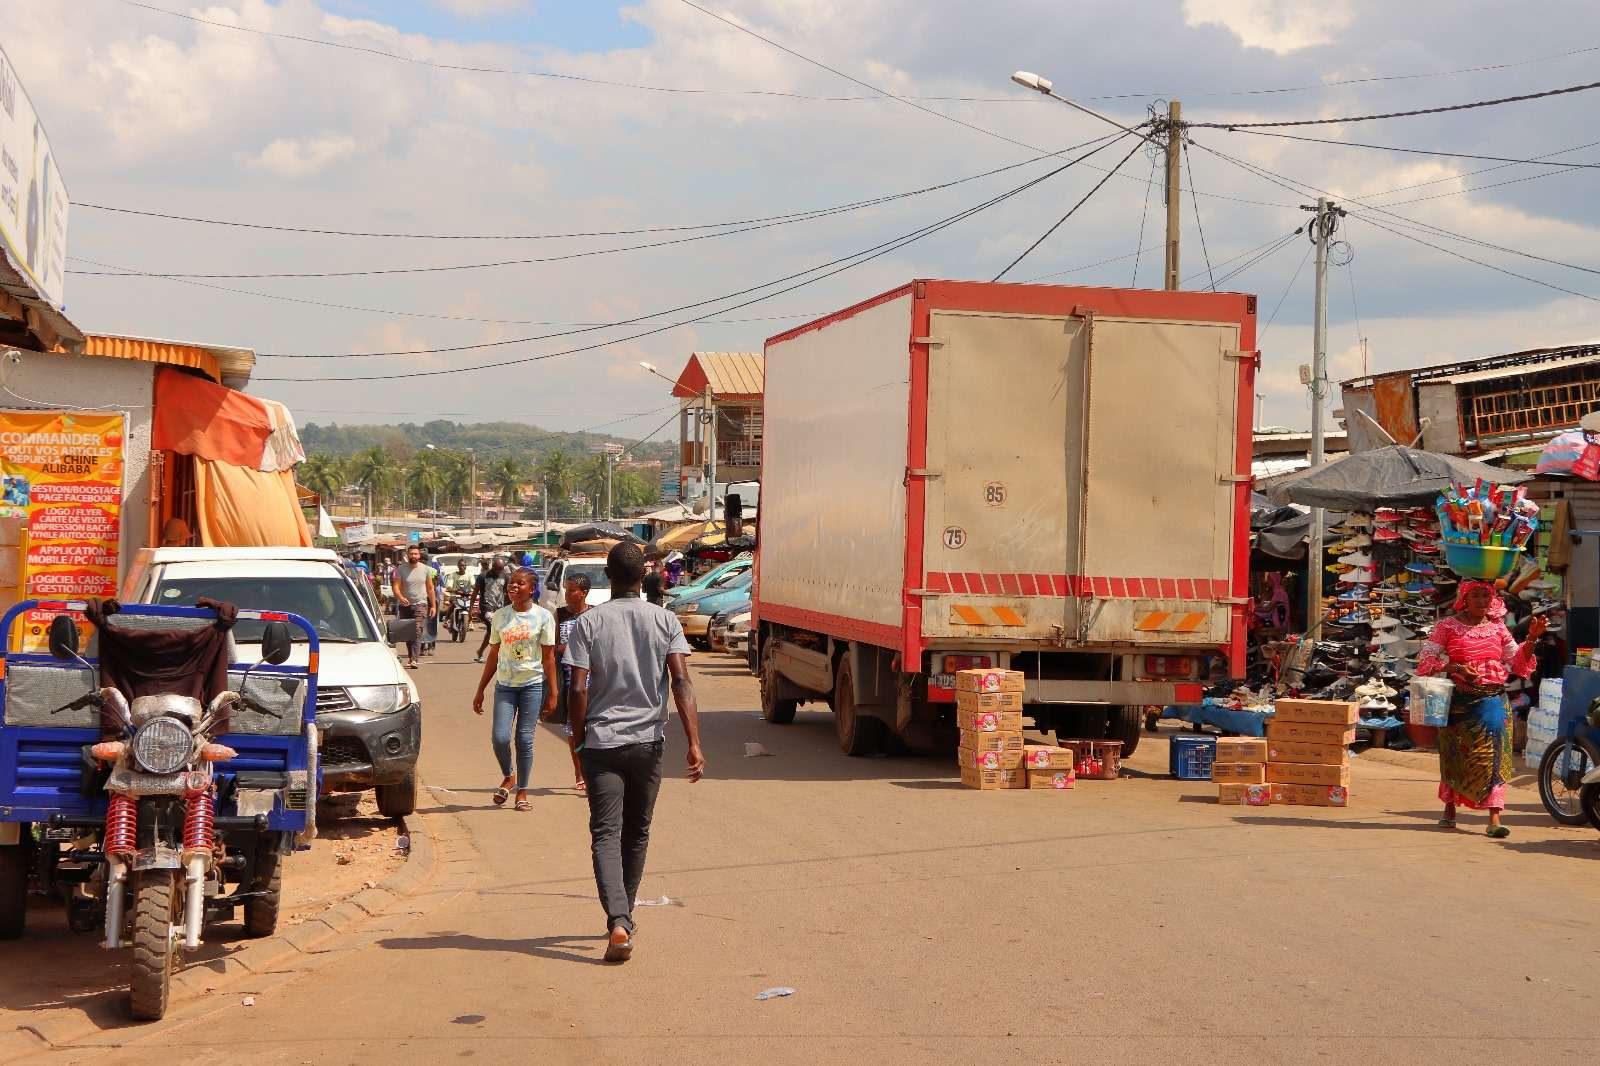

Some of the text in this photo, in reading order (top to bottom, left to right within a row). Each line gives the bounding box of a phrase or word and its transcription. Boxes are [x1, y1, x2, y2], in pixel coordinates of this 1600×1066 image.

[0, 432, 100, 445] COMMANDER
[2, 445, 113, 456] TOUT VOS ARTICLES
[9, 455, 98, 465] DEPUIS LA CHINE
[42, 464, 91, 474] ALIBABA
[38, 494, 113, 503] PAGE FACEBOOK
[986, 486, 1003, 502] 85
[45, 508, 70, 516] LOGO
[77, 508, 103, 516] FLYER
[40, 516, 67, 524] CARTE
[69, 516, 80, 524] DE
[33, 524, 85, 532] IMPRESSION
[59, 531, 118, 540] AUTOCOLLANT
[946, 530, 961, 545] 75
[40, 546, 107, 556] APPLICATION
[28, 555, 67, 565] MOBILE
[75, 555, 88, 565] PC
[95, 556, 116, 565] WEB
[30, 574, 111, 585] LOGICIEL CAISSE
[36, 584, 105, 594] GESTION PDV
